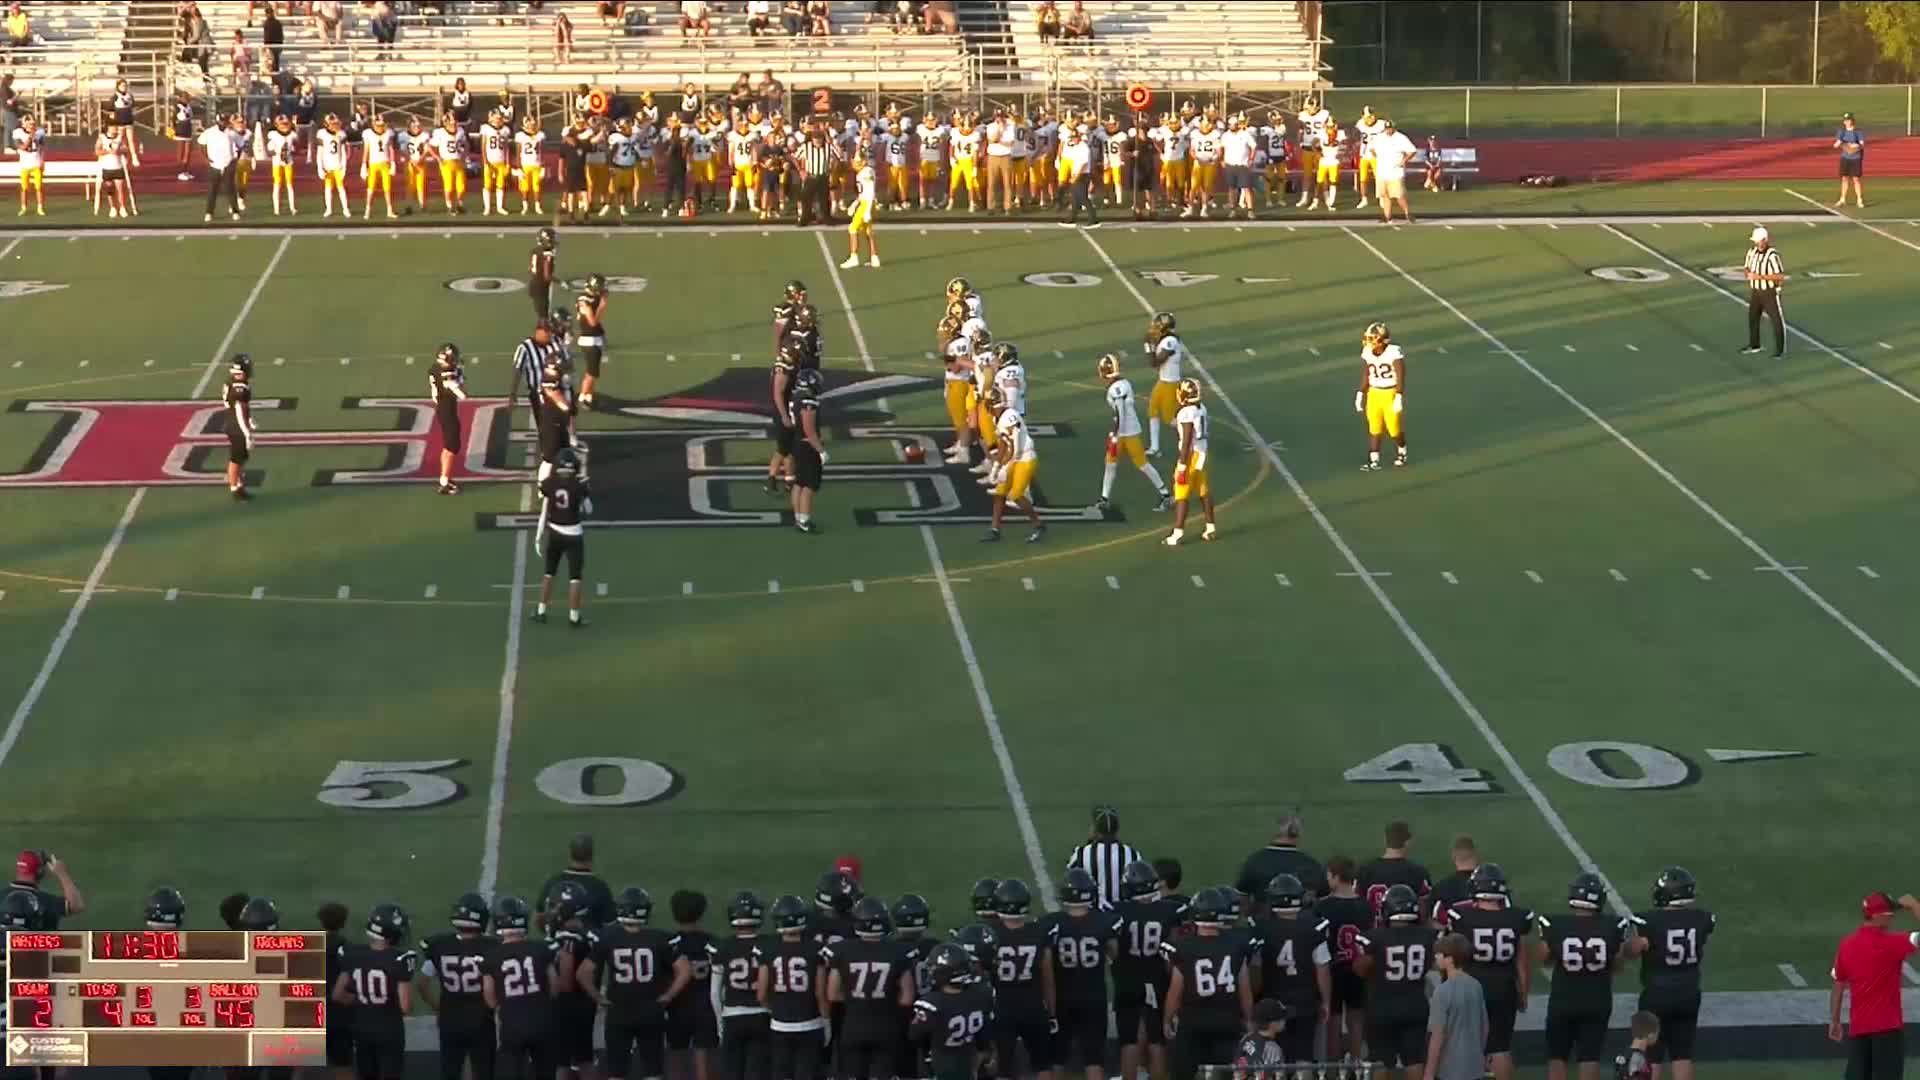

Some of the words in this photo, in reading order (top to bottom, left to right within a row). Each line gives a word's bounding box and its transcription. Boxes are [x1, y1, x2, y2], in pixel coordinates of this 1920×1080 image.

[815, 90, 832, 113] 2
[1104, 141, 1121, 155] 16
[1058, 937, 1100, 968] 86
[1129, 921, 1162, 956] 18
[1472, 928, 1516, 963] 56
[1562, 937, 1607, 972] 63
[1665, 928, 1698, 966] 51
[440, 955, 481, 993] 52
[613, 948, 654, 983] 50
[772, 956, 809, 992] 16
[997, 945, 1037, 982] 67
[1276, 939, 1298, 976] 4
[1385, 944, 1426, 981] 58
[352, 967, 388, 1004] 10
[501, 956, 540, 998] 21
[850, 962, 891, 998] 77
[1195, 955, 1235, 997] 64
[945, 1010, 984, 1047] 29
